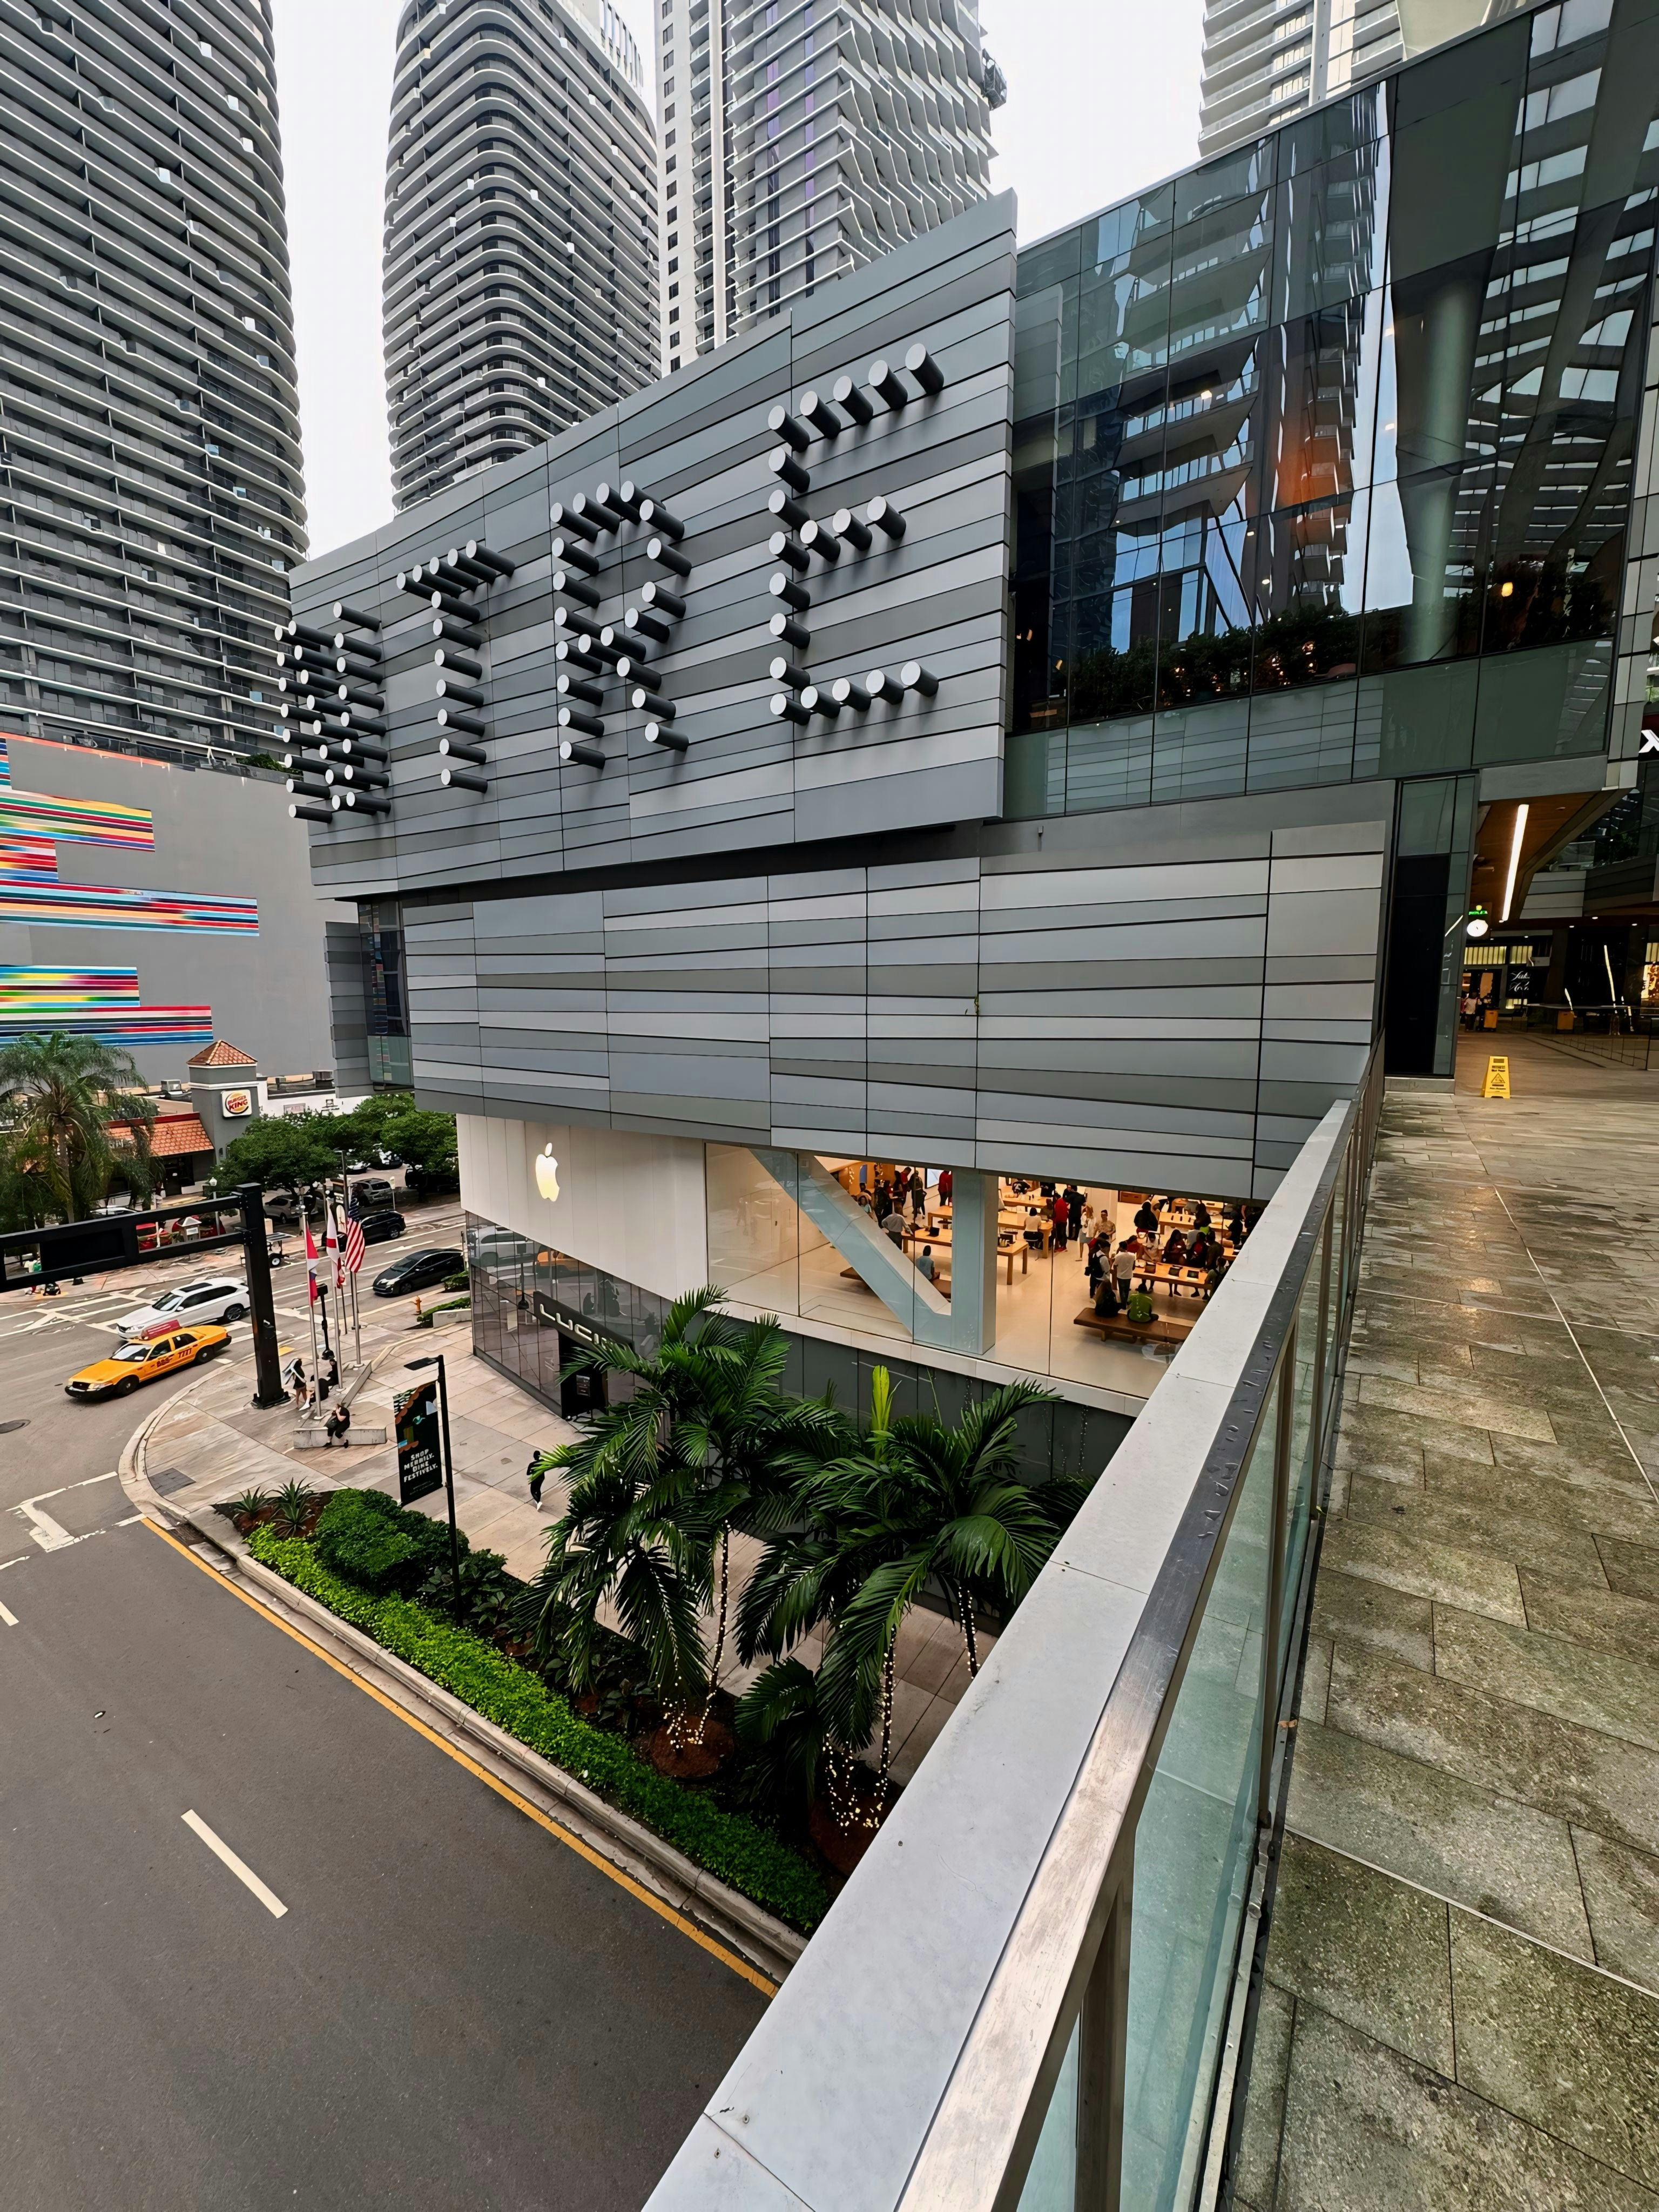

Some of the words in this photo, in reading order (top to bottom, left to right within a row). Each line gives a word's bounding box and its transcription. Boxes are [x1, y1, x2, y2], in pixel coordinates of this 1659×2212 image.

[228, 1099, 248, 1111] KING
[410, 1449, 429, 1461] SHOP
[403, 1453, 435, 1471] MERRILY.
[412, 1461, 429, 1473] DINE
[403, 1463, 439, 1483] FESTIVELY.
